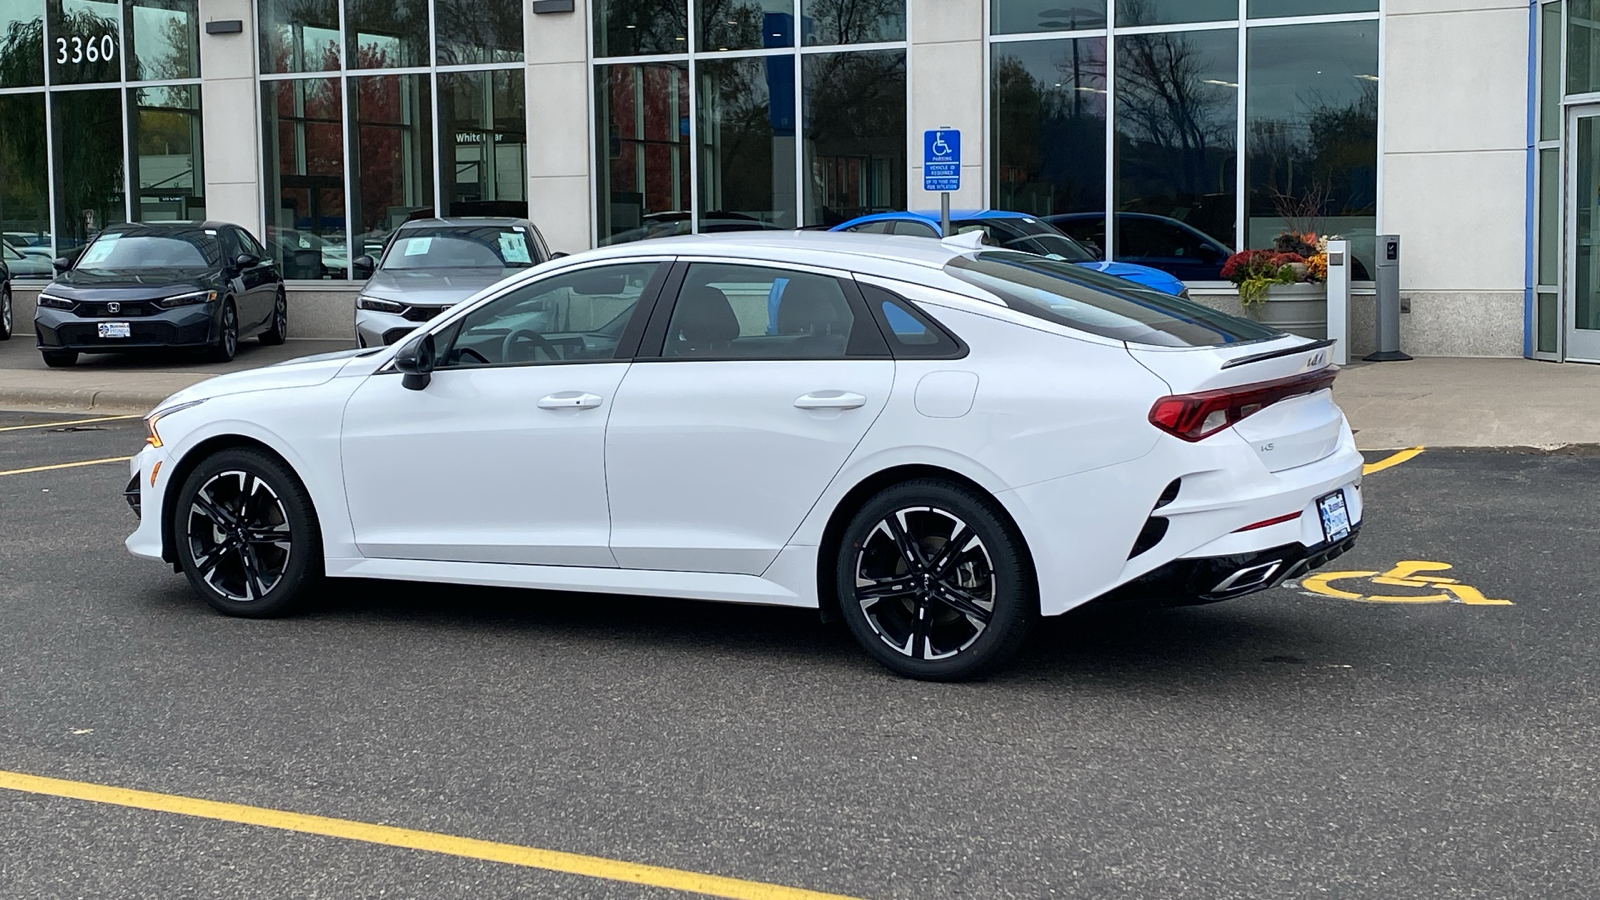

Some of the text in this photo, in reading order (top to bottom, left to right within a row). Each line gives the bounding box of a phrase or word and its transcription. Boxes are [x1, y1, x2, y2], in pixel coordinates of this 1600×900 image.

[56, 34, 114, 64] 3360
[455, 132, 480, 142] White
[1260, 443, 1274, 452] K5
